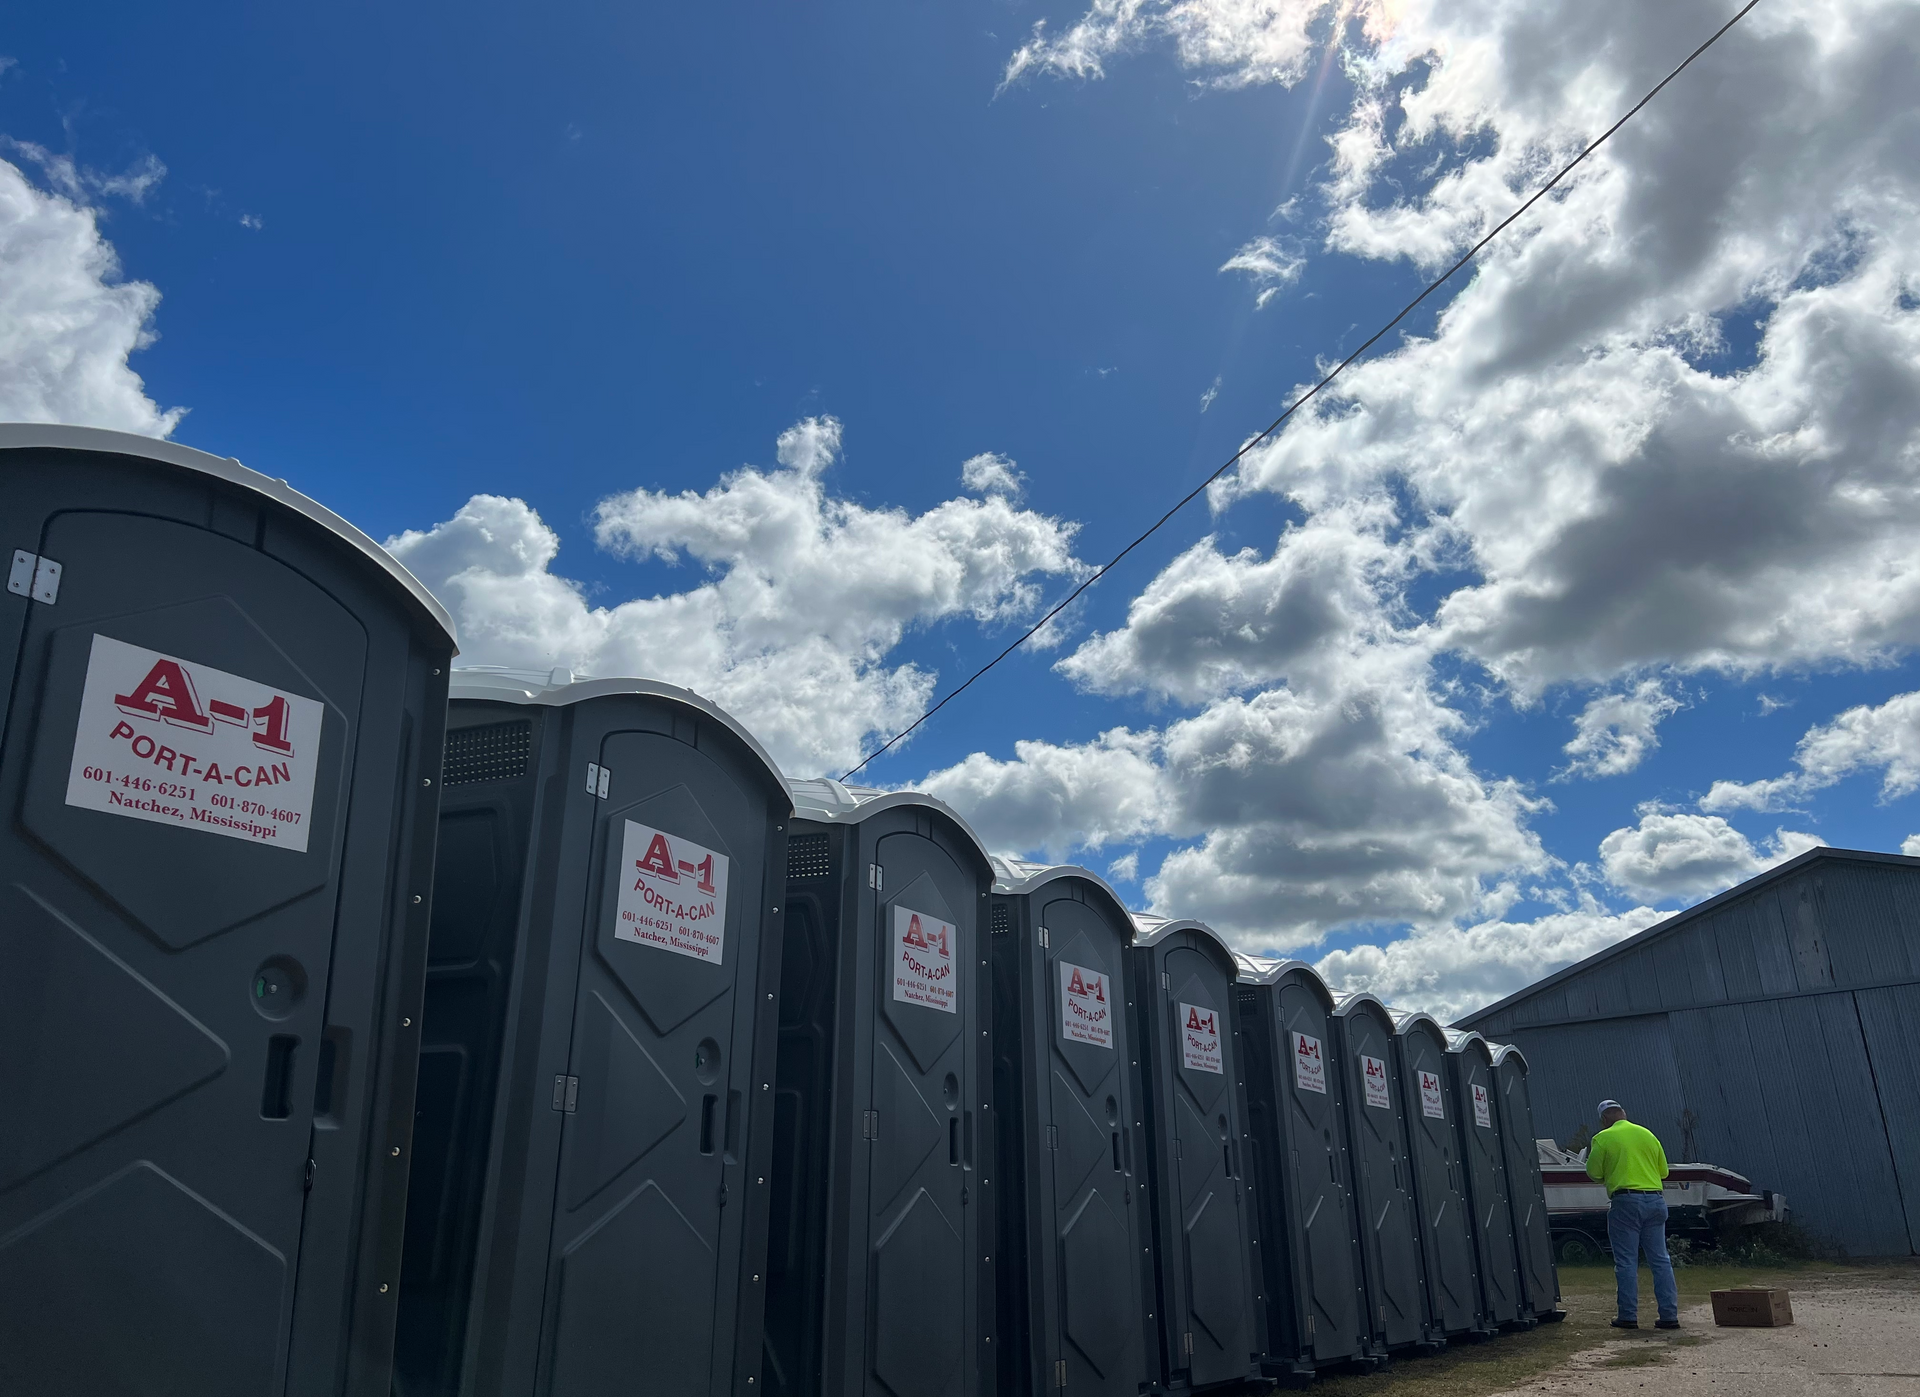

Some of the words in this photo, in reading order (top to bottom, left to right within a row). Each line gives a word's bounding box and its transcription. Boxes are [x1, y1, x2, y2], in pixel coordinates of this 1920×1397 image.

[114, 658, 294, 758] A-1
[109, 720, 291, 787] PORT-A-CAN
[108, 790, 184, 820] Natchez,
[189, 807, 277, 839] Mississippi
[635, 833, 716, 898] A-1
[633, 878, 715, 920] PORT-A-CAN
[633, 927, 668, 946] Natchez,
[669, 936, 709, 957] Mississippi
[902, 913, 950, 960] A-1
[902, 951, 950, 980] PORT-A-CAN
[1067, 967, 1106, 1005] A-1
[1068, 998, 1107, 1022] PORT-A-CAN
[1186, 1006, 1216, 1037] A-1
[1298, 1035, 1320, 1061] A-1
[1366, 1058, 1384, 1079] A-1
[1423, 1073, 1438, 1092] A-1
